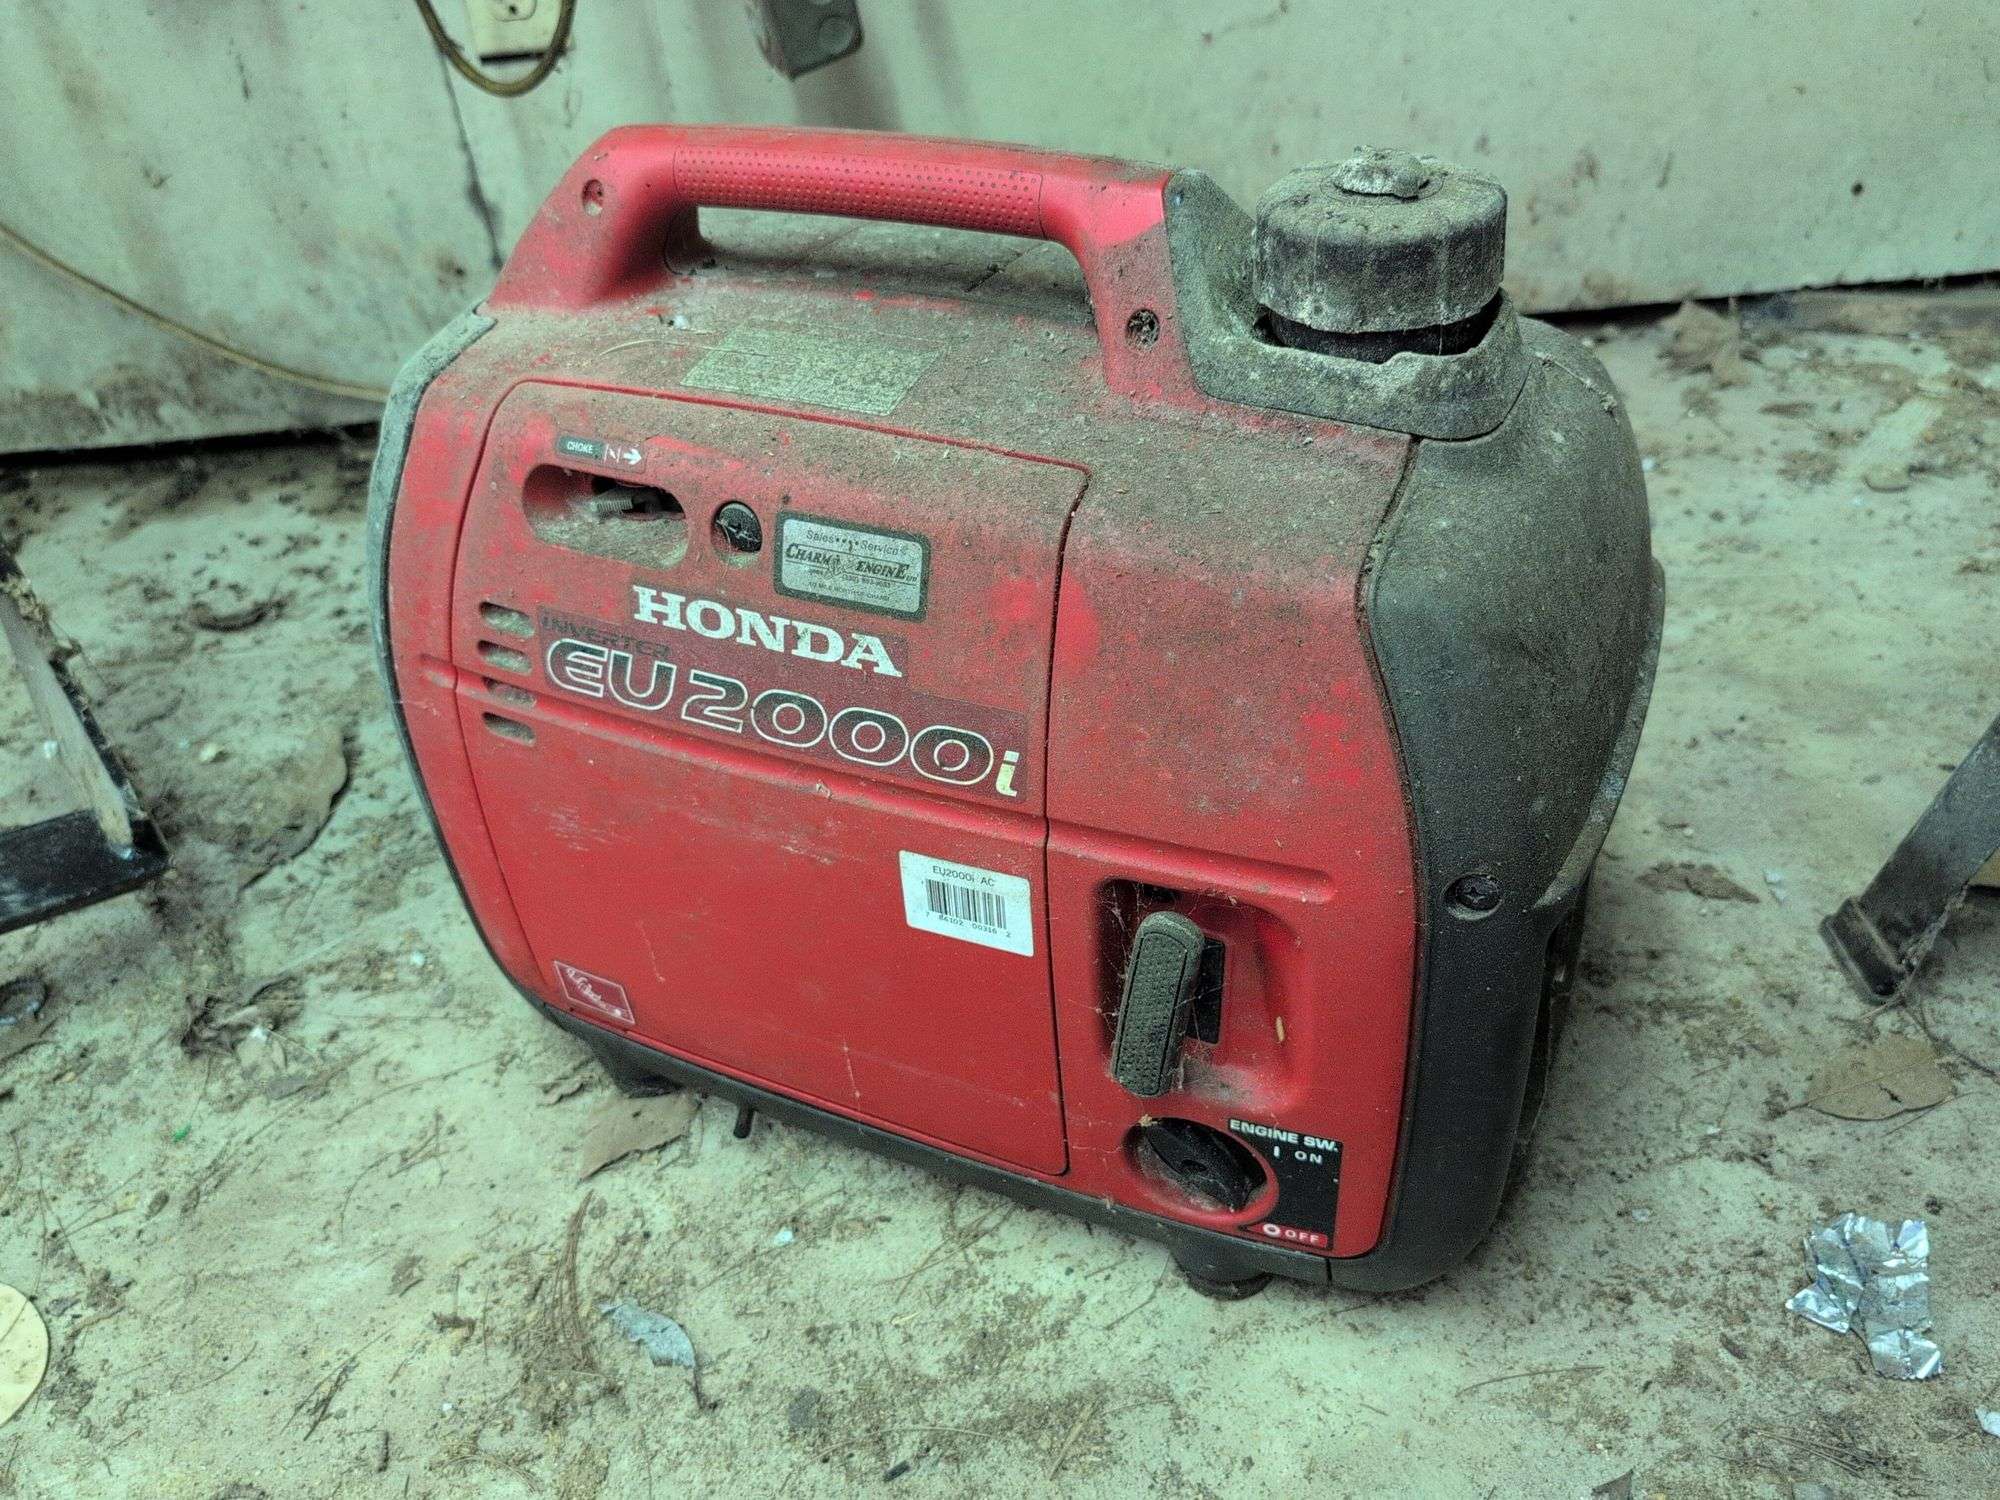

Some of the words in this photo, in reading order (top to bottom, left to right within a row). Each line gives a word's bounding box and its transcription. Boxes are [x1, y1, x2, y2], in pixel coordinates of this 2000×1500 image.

[567, 441, 593, 454] CHOKE
[806, 530, 835, 543] Sales
[855, 561, 910, 580] ENGINE
[633, 585, 902, 678] HONDA
[980, 877, 994, 887] AC
[1230, 1119, 1299, 1144] ENGINE
[1303, 1136, 1339, 1152] SW.
[1294, 1150, 1323, 1164] ON
[1285, 1229, 1320, 1243] OFF
